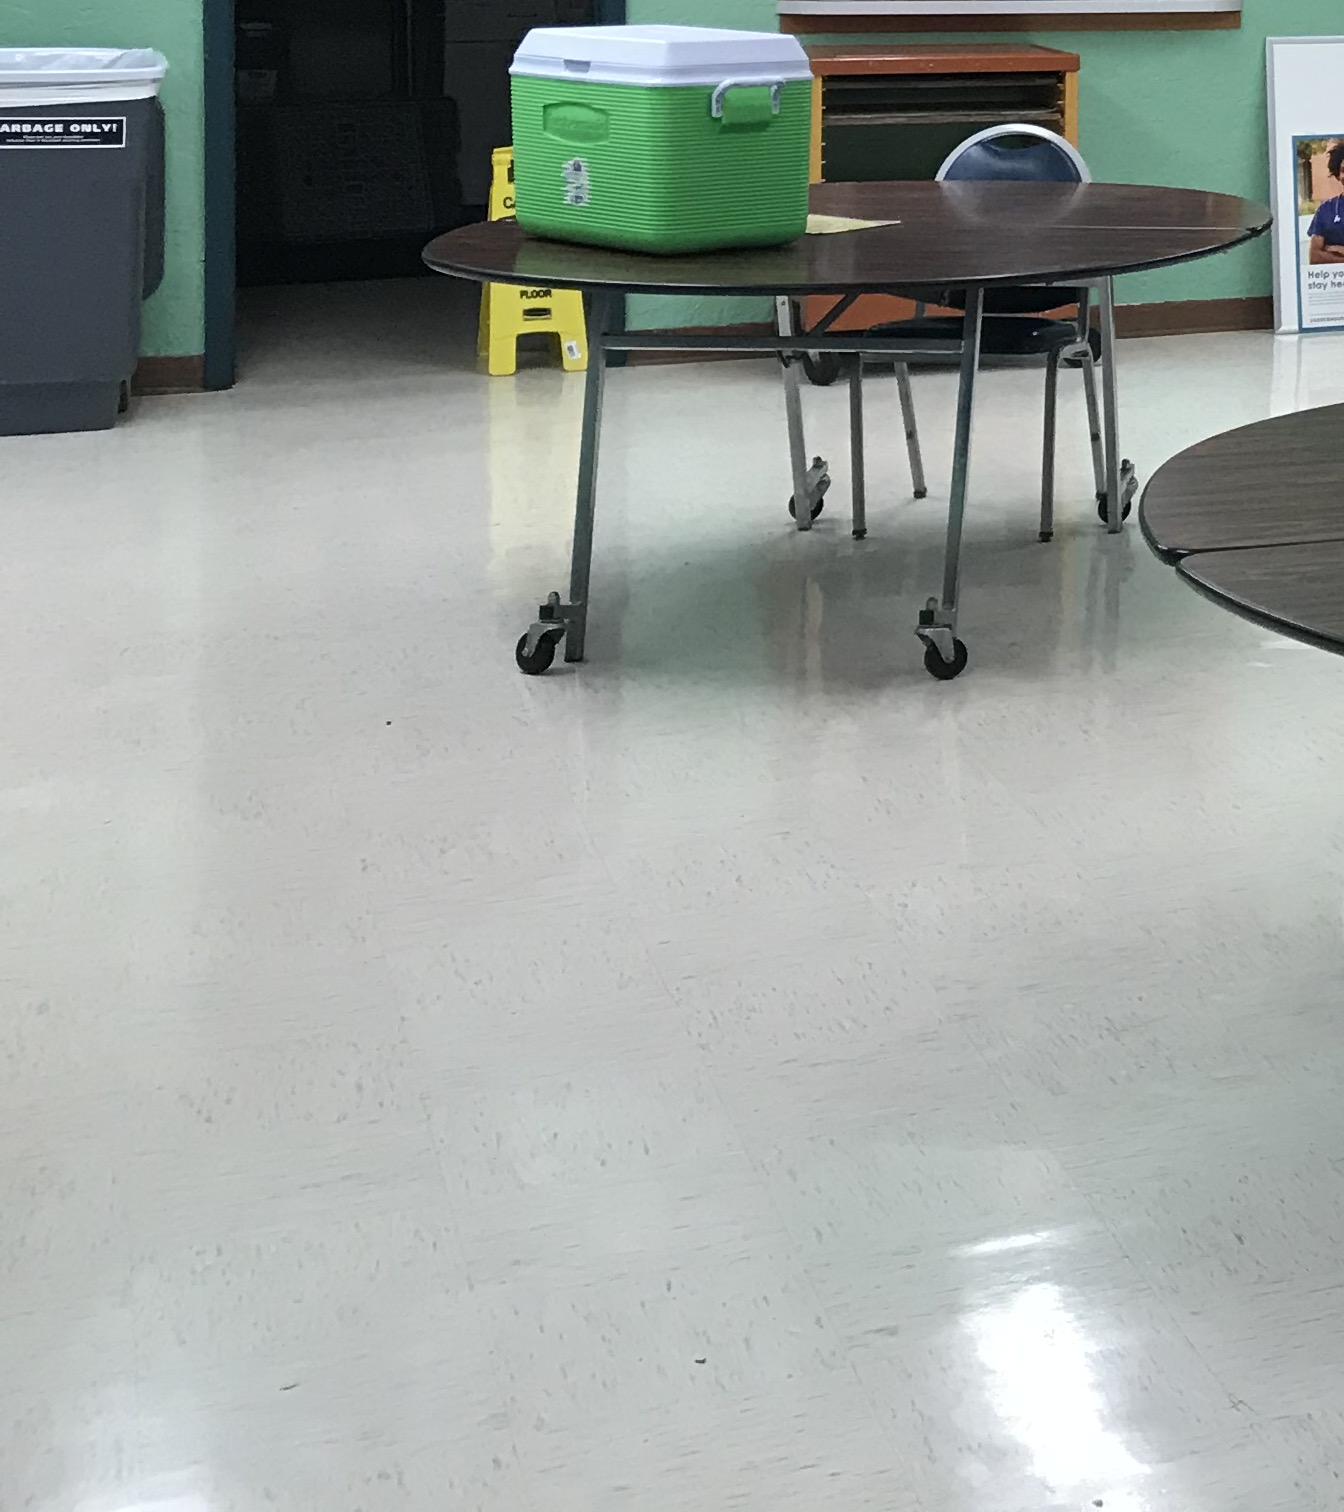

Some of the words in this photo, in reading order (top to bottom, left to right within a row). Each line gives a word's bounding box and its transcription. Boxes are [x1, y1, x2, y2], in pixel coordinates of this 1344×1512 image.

[0, 123, 64, 132] ARBAGE
[69, 123, 118, 132] ONLY!
[1308, 269, 1330, 279] Help
[1307, 280, 1328, 290] stay
[520, 289, 552, 299] FLOOR
